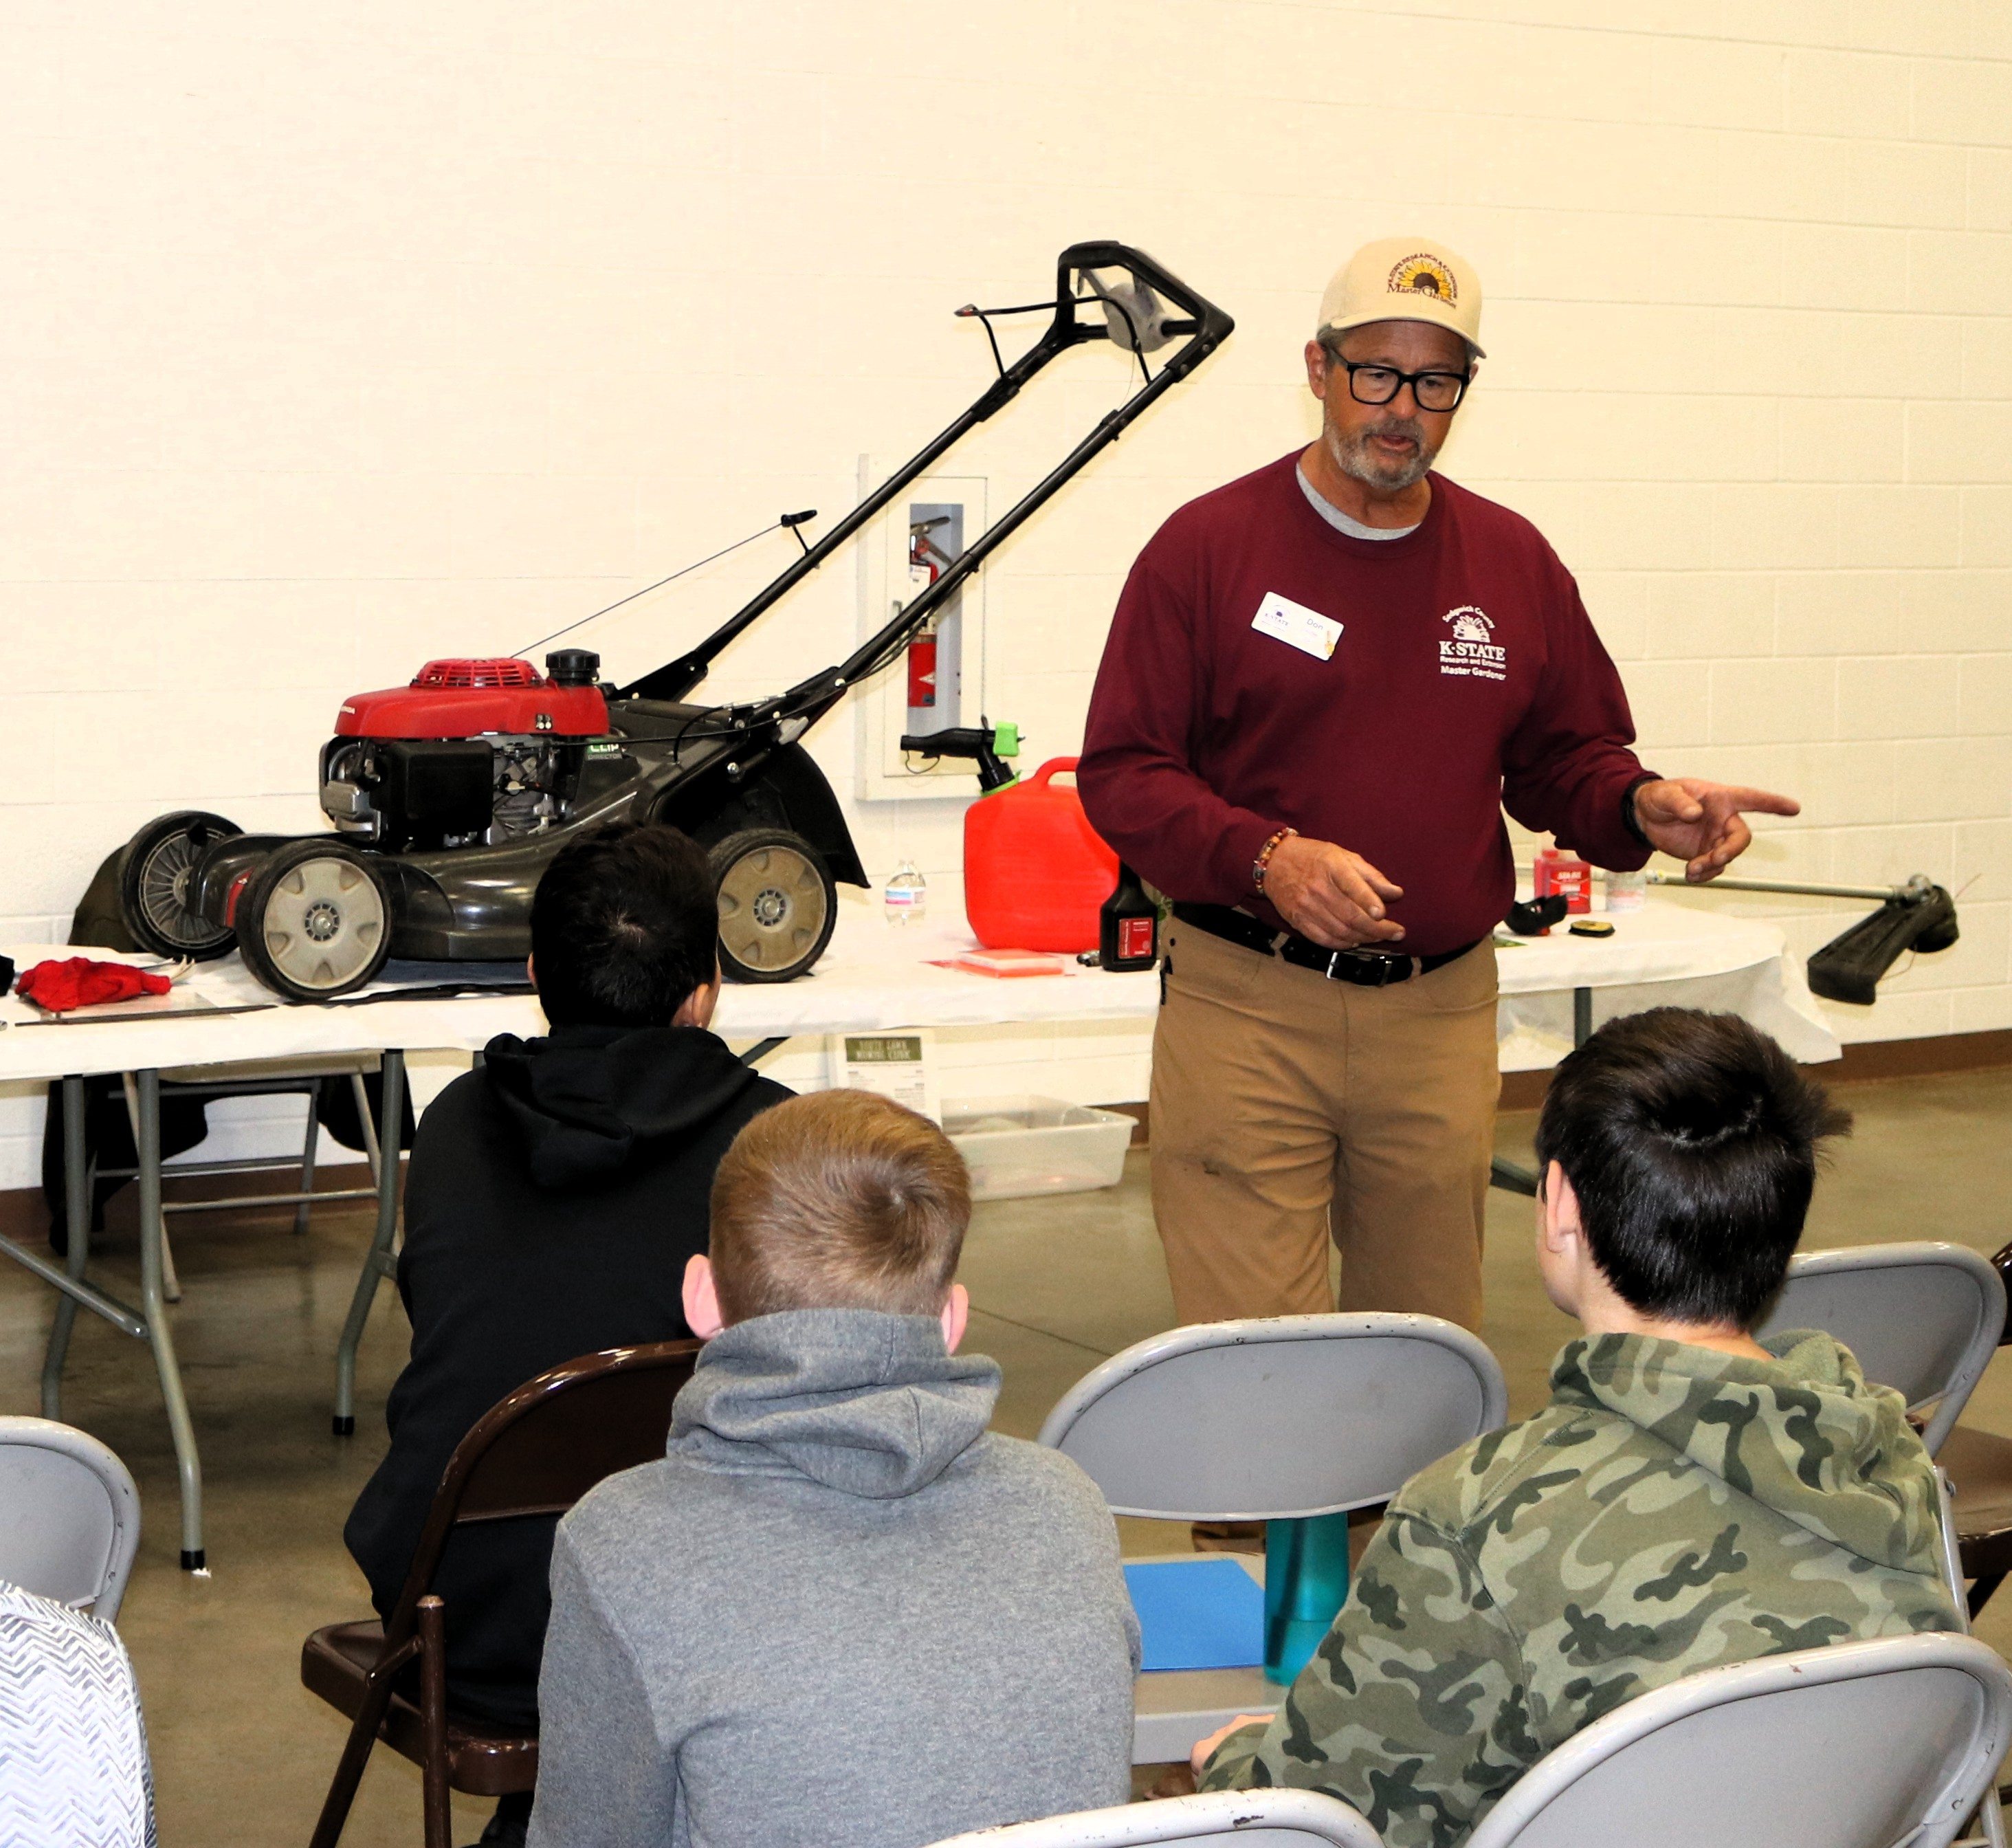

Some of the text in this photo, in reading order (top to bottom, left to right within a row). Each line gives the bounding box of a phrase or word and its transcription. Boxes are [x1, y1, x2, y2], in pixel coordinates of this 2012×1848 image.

[1386, 283, 1422, 294] Master
[1306, 618, 1324, 630] Don
[1439, 641, 1505, 661] K-STATE
[1441, 666, 1507, 681] Master Gardener
